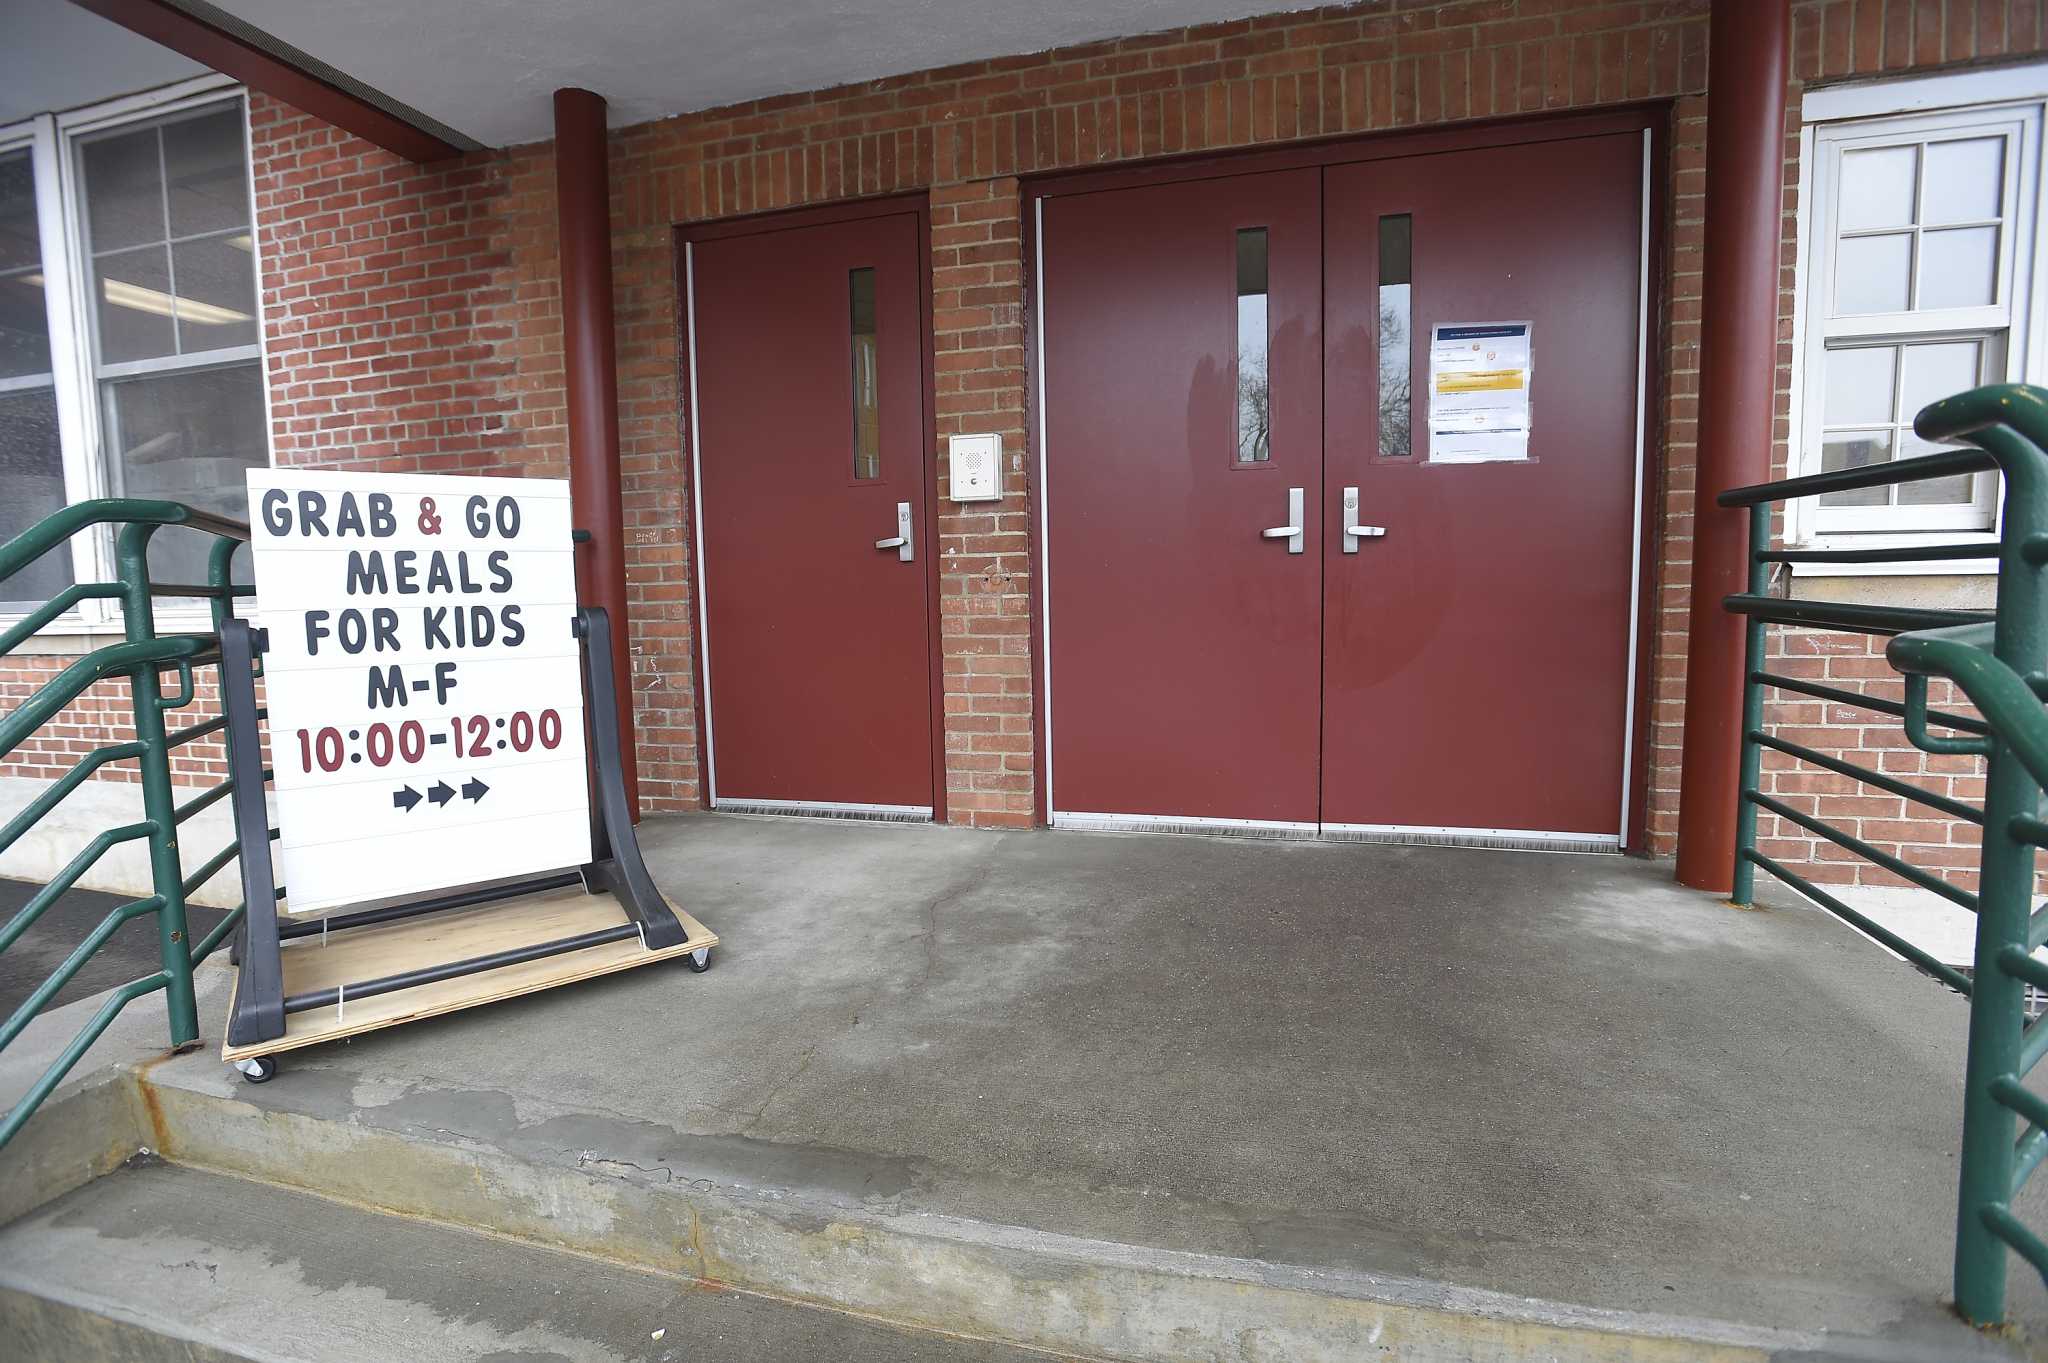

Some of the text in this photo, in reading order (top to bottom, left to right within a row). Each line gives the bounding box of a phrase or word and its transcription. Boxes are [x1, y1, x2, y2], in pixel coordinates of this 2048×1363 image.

[262, 489, 520, 538] GRAB & GO
[347, 551, 512, 594] MEALS
[305, 605, 525, 656] FOR KIDS
[368, 662, 457, 709] M-F
[297, 709, 561, 773] 10:00-12:00
